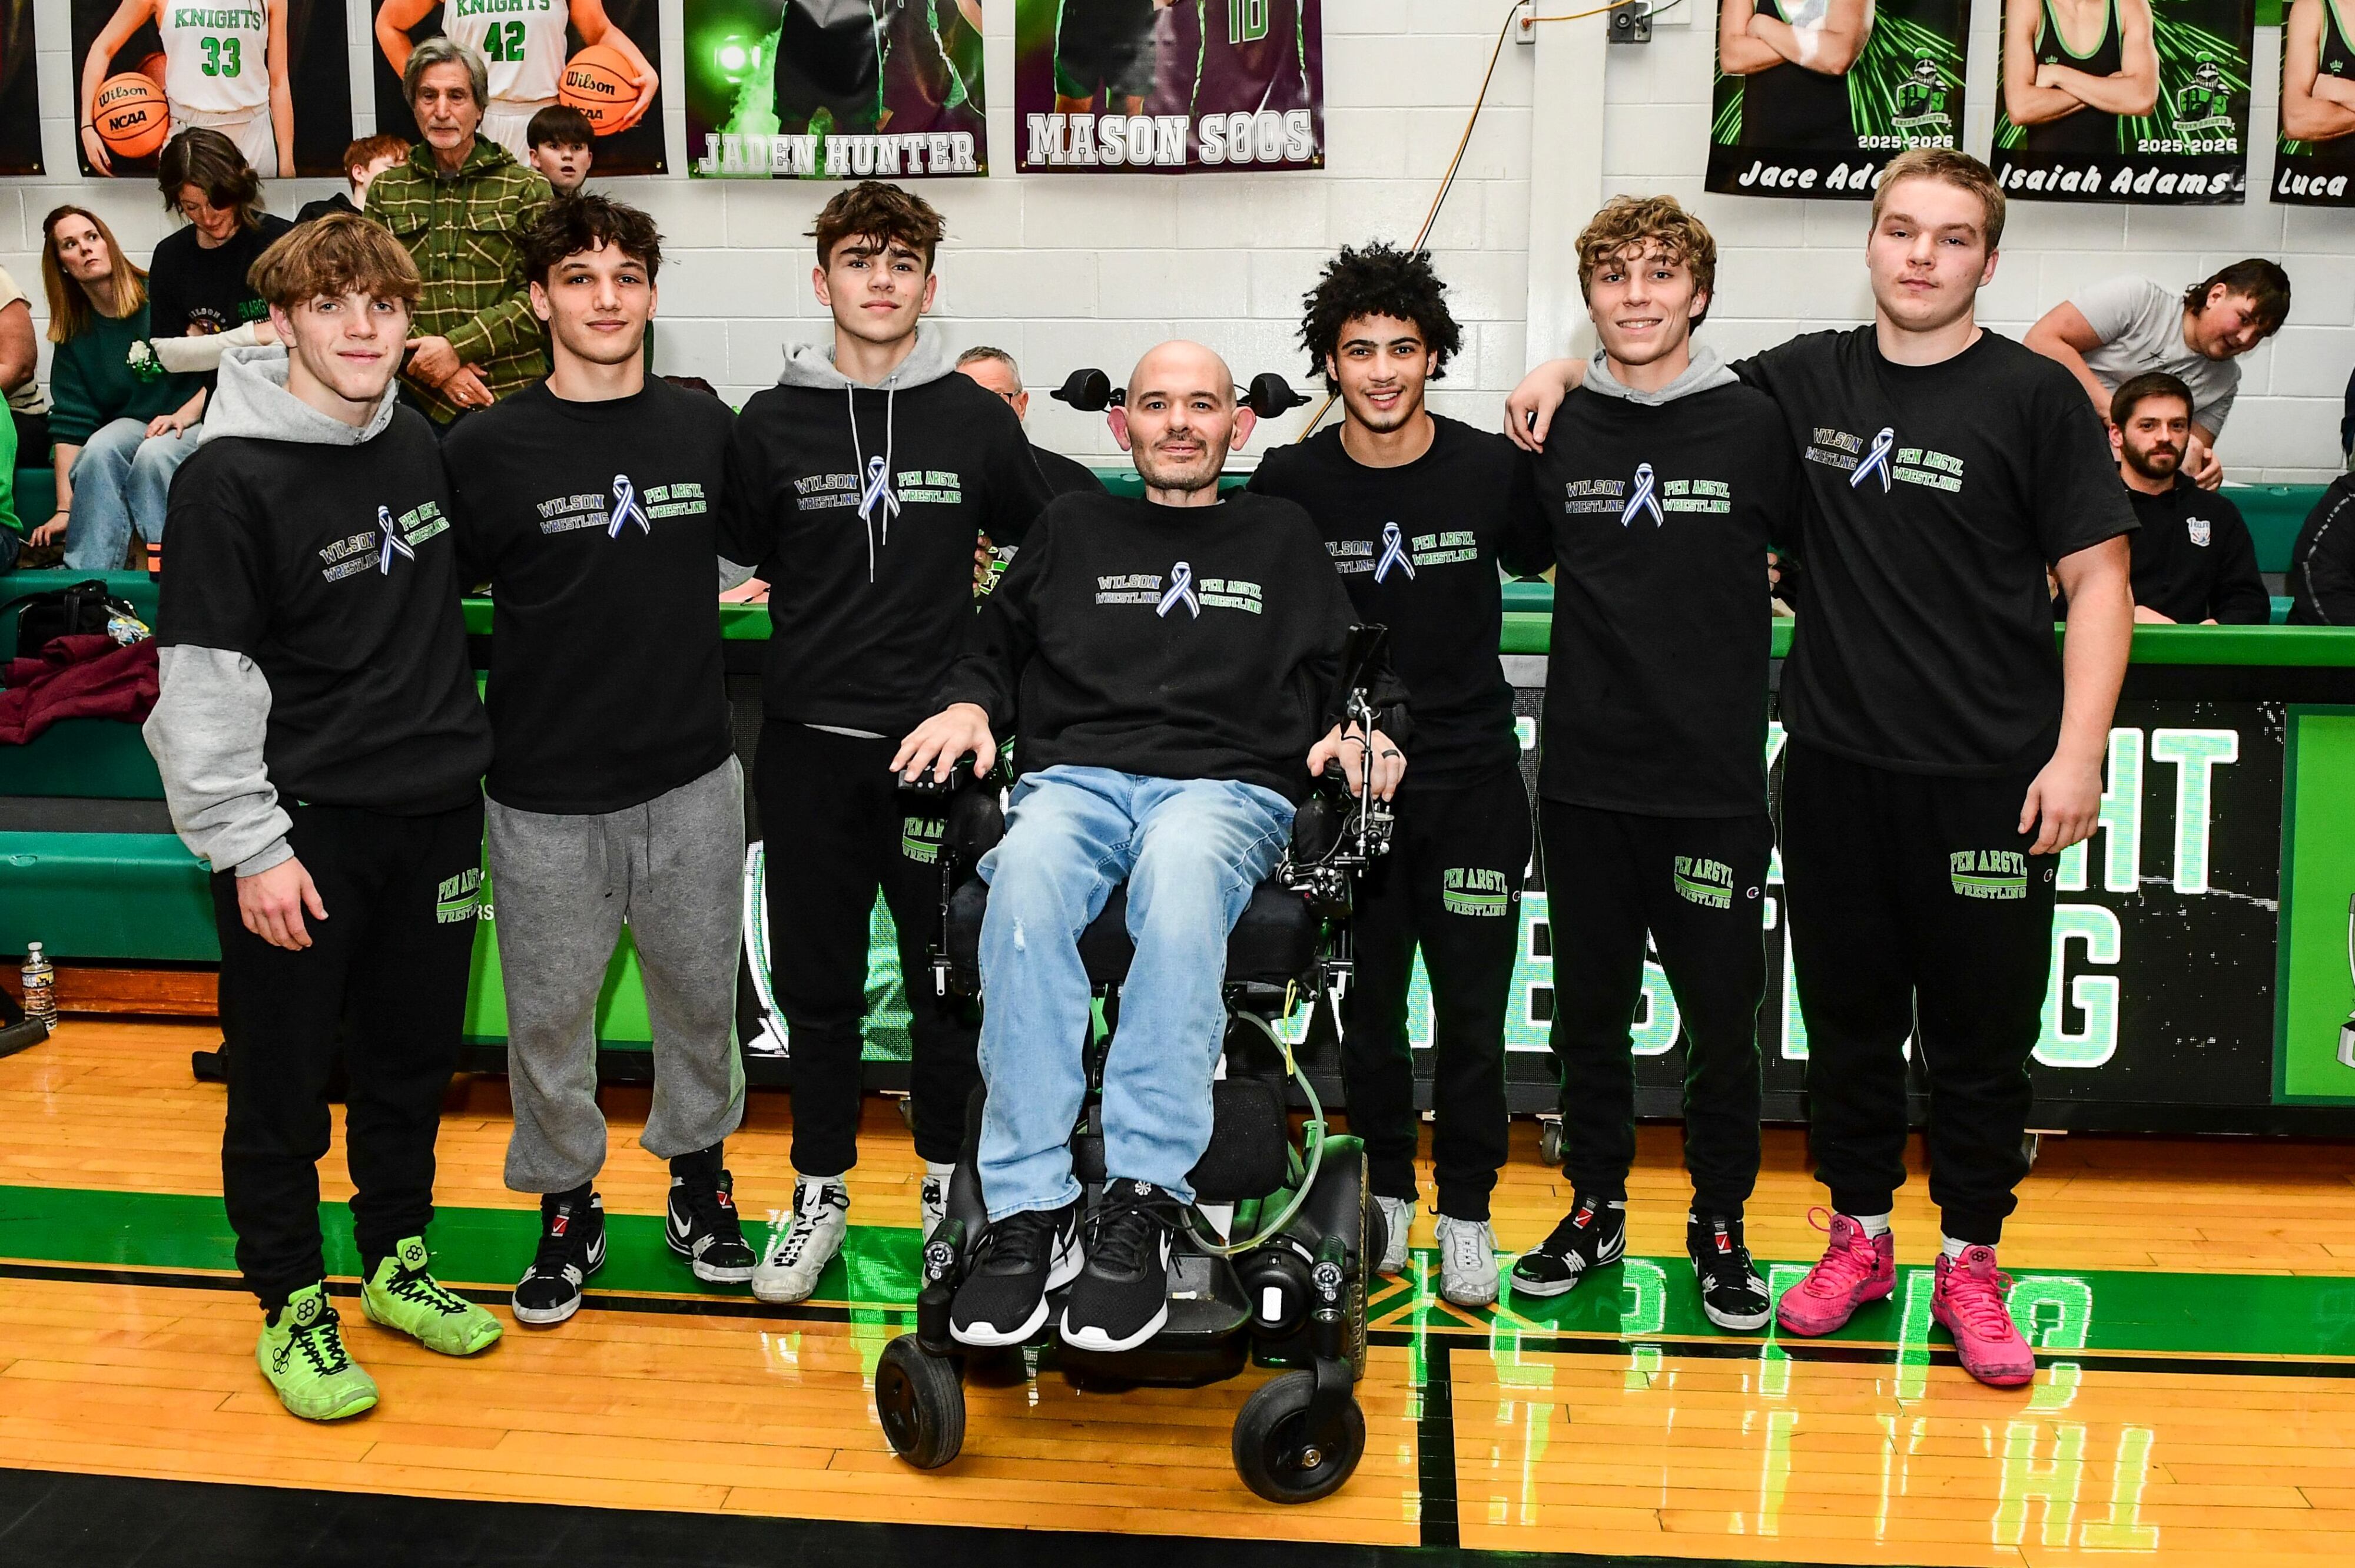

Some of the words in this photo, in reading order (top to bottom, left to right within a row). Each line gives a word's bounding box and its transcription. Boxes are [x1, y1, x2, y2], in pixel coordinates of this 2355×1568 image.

[175, 8, 260, 31] KNIGHTS
[483, 21, 525, 62] 42
[201, 37, 241, 77] 33
[566, 71, 615, 95] Wilson
[99, 87, 147, 108] Wilson
[109, 110, 147, 131] NCAA
[1027, 113, 1189, 166] MASON
[1199, 108, 1313, 165] SOOS
[1858, 135, 1955, 149] 2025-2026
[2138, 138, 2238, 153] 2025-2026
[699, 133, 818, 175] JADEN
[825, 131, 977, 175] HUNTER
[1739, 160, 1818, 189] Jace
[1998, 163, 2102, 193] Isaiah
[2109, 166, 2231, 194] Adams
[2278, 167, 2348, 197] Luca
[1813, 427, 1863, 454] WILSON
[1805, 446, 1858, 470] WRESTLING
[1896, 447, 1923, 465] PEN
[1922, 450, 1963, 476] ARGYL
[794, 474, 858, 495] WILSON
[897, 471, 923, 487] PEN
[925, 471, 960, 488] ARGYL
[1566, 479, 1625, 498] WILSON
[1664, 479, 1689, 495] PEN
[1692, 479, 1730, 498] ARGYL
[1892, 466, 1962, 492] WRESTLING
[644, 485, 669, 504] PEN
[671, 483, 705, 498] ARGYL
[797, 493, 860, 510] WRESTLING
[897, 489, 961, 503] WRESTLING
[537, 494, 605, 518] WILSON
[645, 500, 706, 519] WRESTLING
[1565, 500, 1625, 513] WRESTLING
[1663, 499, 1730, 513] WRESTLING
[398, 509, 420, 532] PEN
[404, 516, 450, 546] WRESTLING
[540, 512, 609, 535] WRESTLING
[319, 531, 376, 565] WILSON
[1412, 534, 1437, 551] PEN
[1440, 531, 1475, 546] ARGYL
[322, 551, 381, 582] WRESTLING
[1335, 559, 1376, 574] STLING
[1412, 548, 1477, 566] WRESTLING
[1097, 574, 1162, 590] WILSON
[1199, 579, 1225, 592] PEN
[1226, 581, 1262, 600] ARGYL
[1096, 591, 1162, 605] WRESTLING
[1198, 593, 1262, 615] WRESTLING
[904, 817, 924, 836] PEN
[902, 844, 937, 864] WREST
[1950, 850, 1975, 873] PEN
[1978, 850, 2027, 876] ARGYL
[1444, 868, 1464, 889] PEN
[1466, 868, 1508, 894] ARGYL
[1674, 856, 1692, 876] PEN
[1692, 858, 1733, 889] ARGYL
[438, 874, 459, 903] PEN
[1675, 881, 1731, 909] WRESTLING
[1952, 883, 2026, 899] WRESTLING
[1444, 900, 1507, 916] WRESTLING
